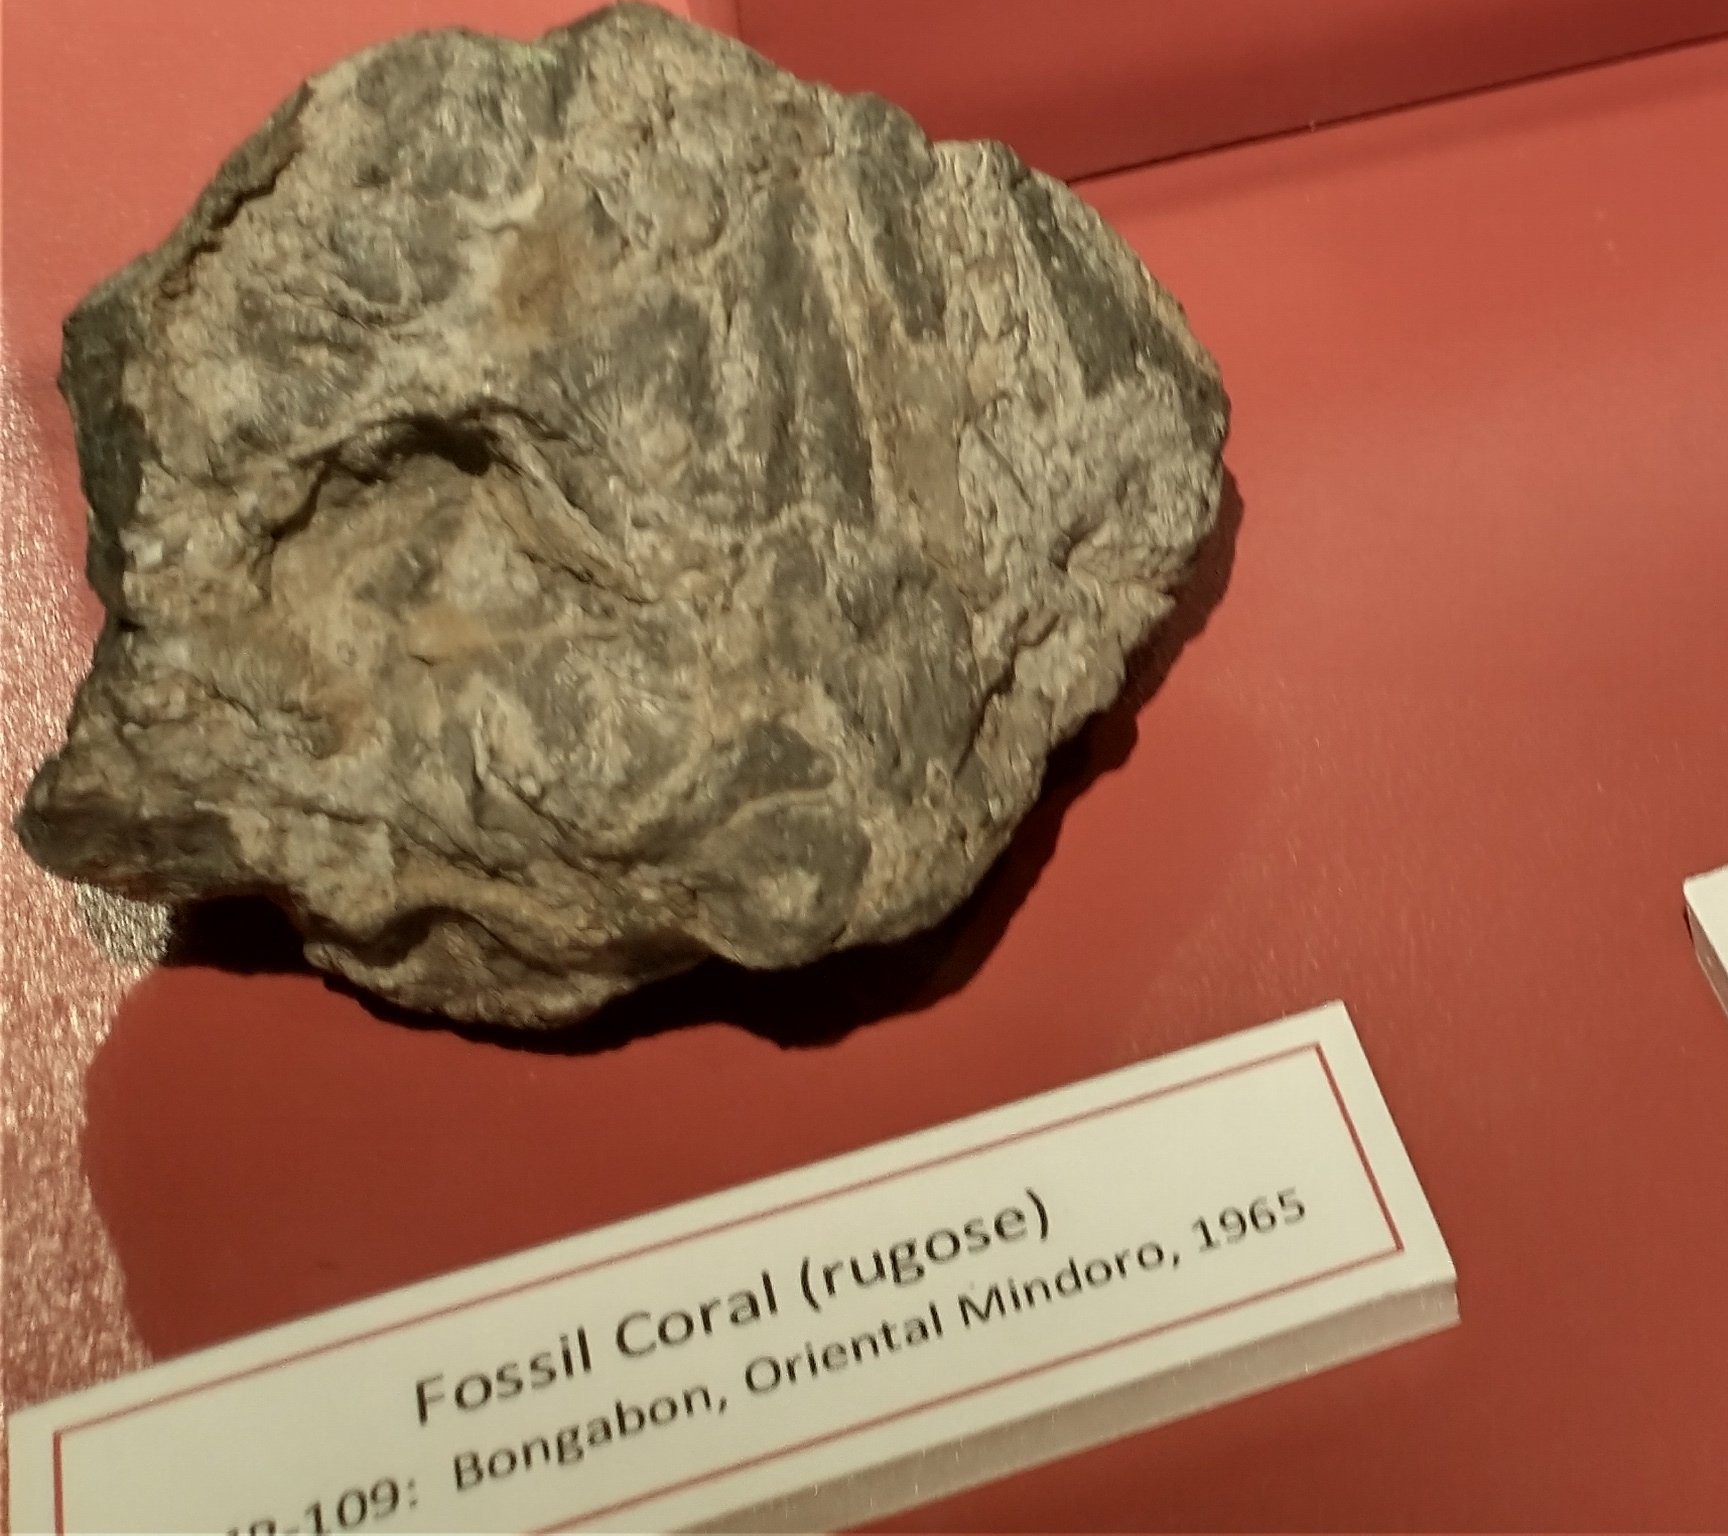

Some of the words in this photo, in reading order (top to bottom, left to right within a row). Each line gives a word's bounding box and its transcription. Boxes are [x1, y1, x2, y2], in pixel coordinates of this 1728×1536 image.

[414, 1324, 593, 1428] Fossil
[614, 1268, 780, 1360] Coral
[798, 1186, 1051, 1316] (rugose)
[451, 1383, 729, 1494] Bongabon,
[743, 1299, 945, 1397] Oriental
[956, 1240, 1182, 1331] Mindoro,
[1190, 1187, 1307, 1253] 1965
